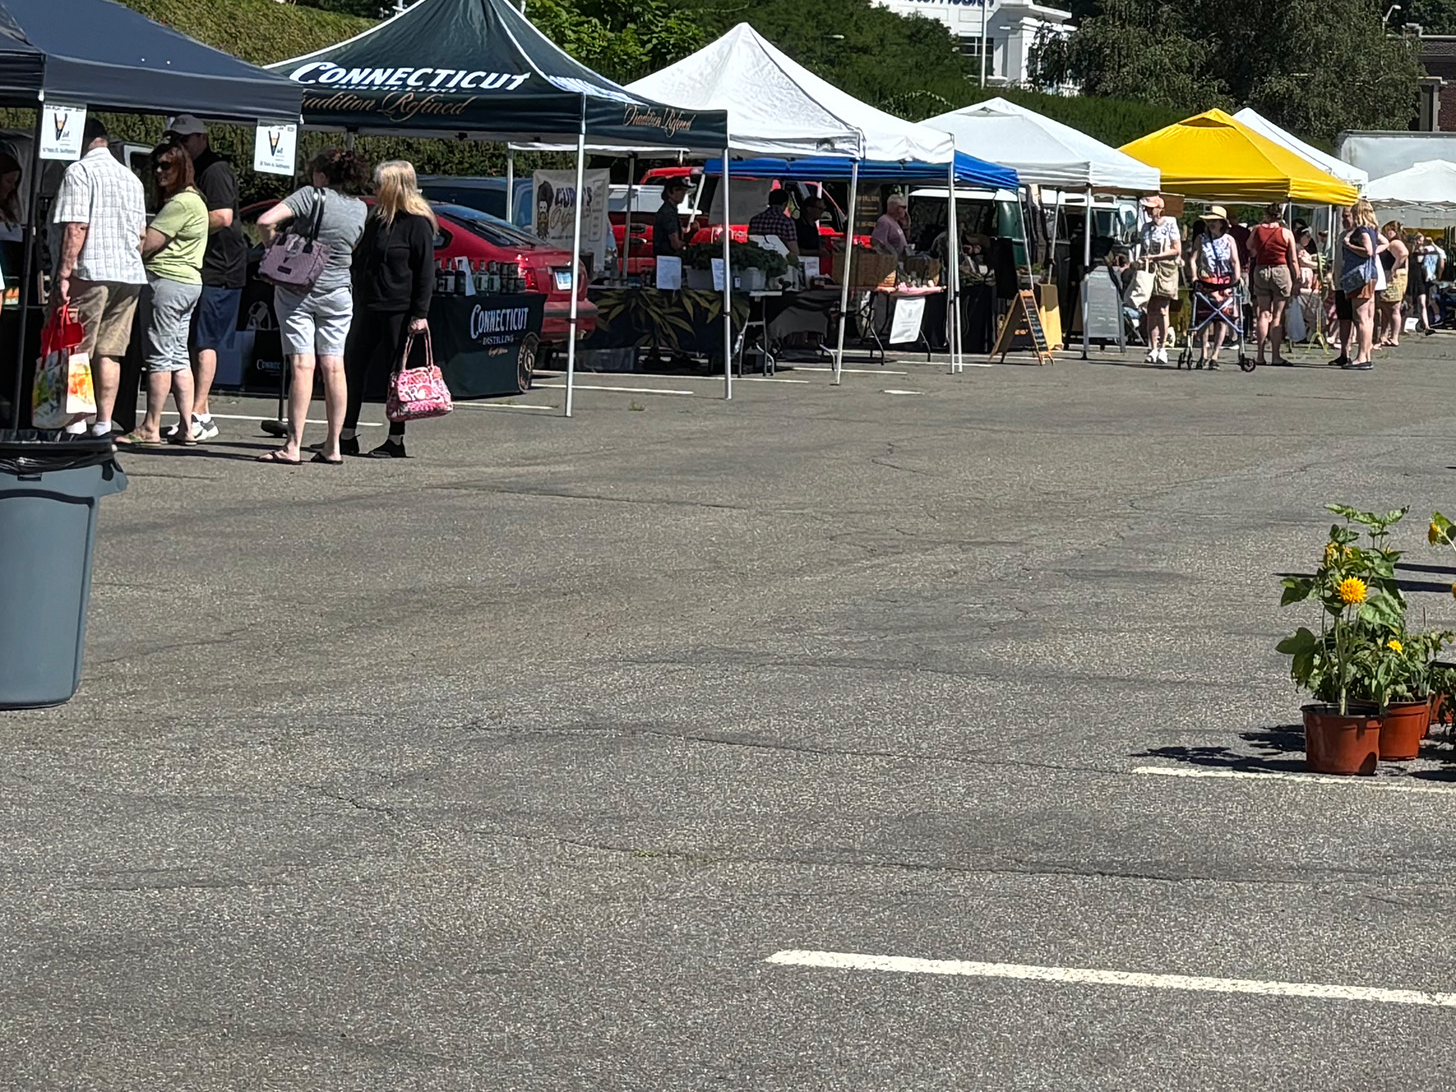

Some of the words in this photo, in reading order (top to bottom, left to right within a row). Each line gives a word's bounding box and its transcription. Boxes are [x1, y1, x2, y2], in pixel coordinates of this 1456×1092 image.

[289, 61, 531, 91] CONNECTICUT
[302, 88, 376, 111] radition
[377, 91, 478, 122] Refined
[470, 304, 530, 340] CONNECTICUT
